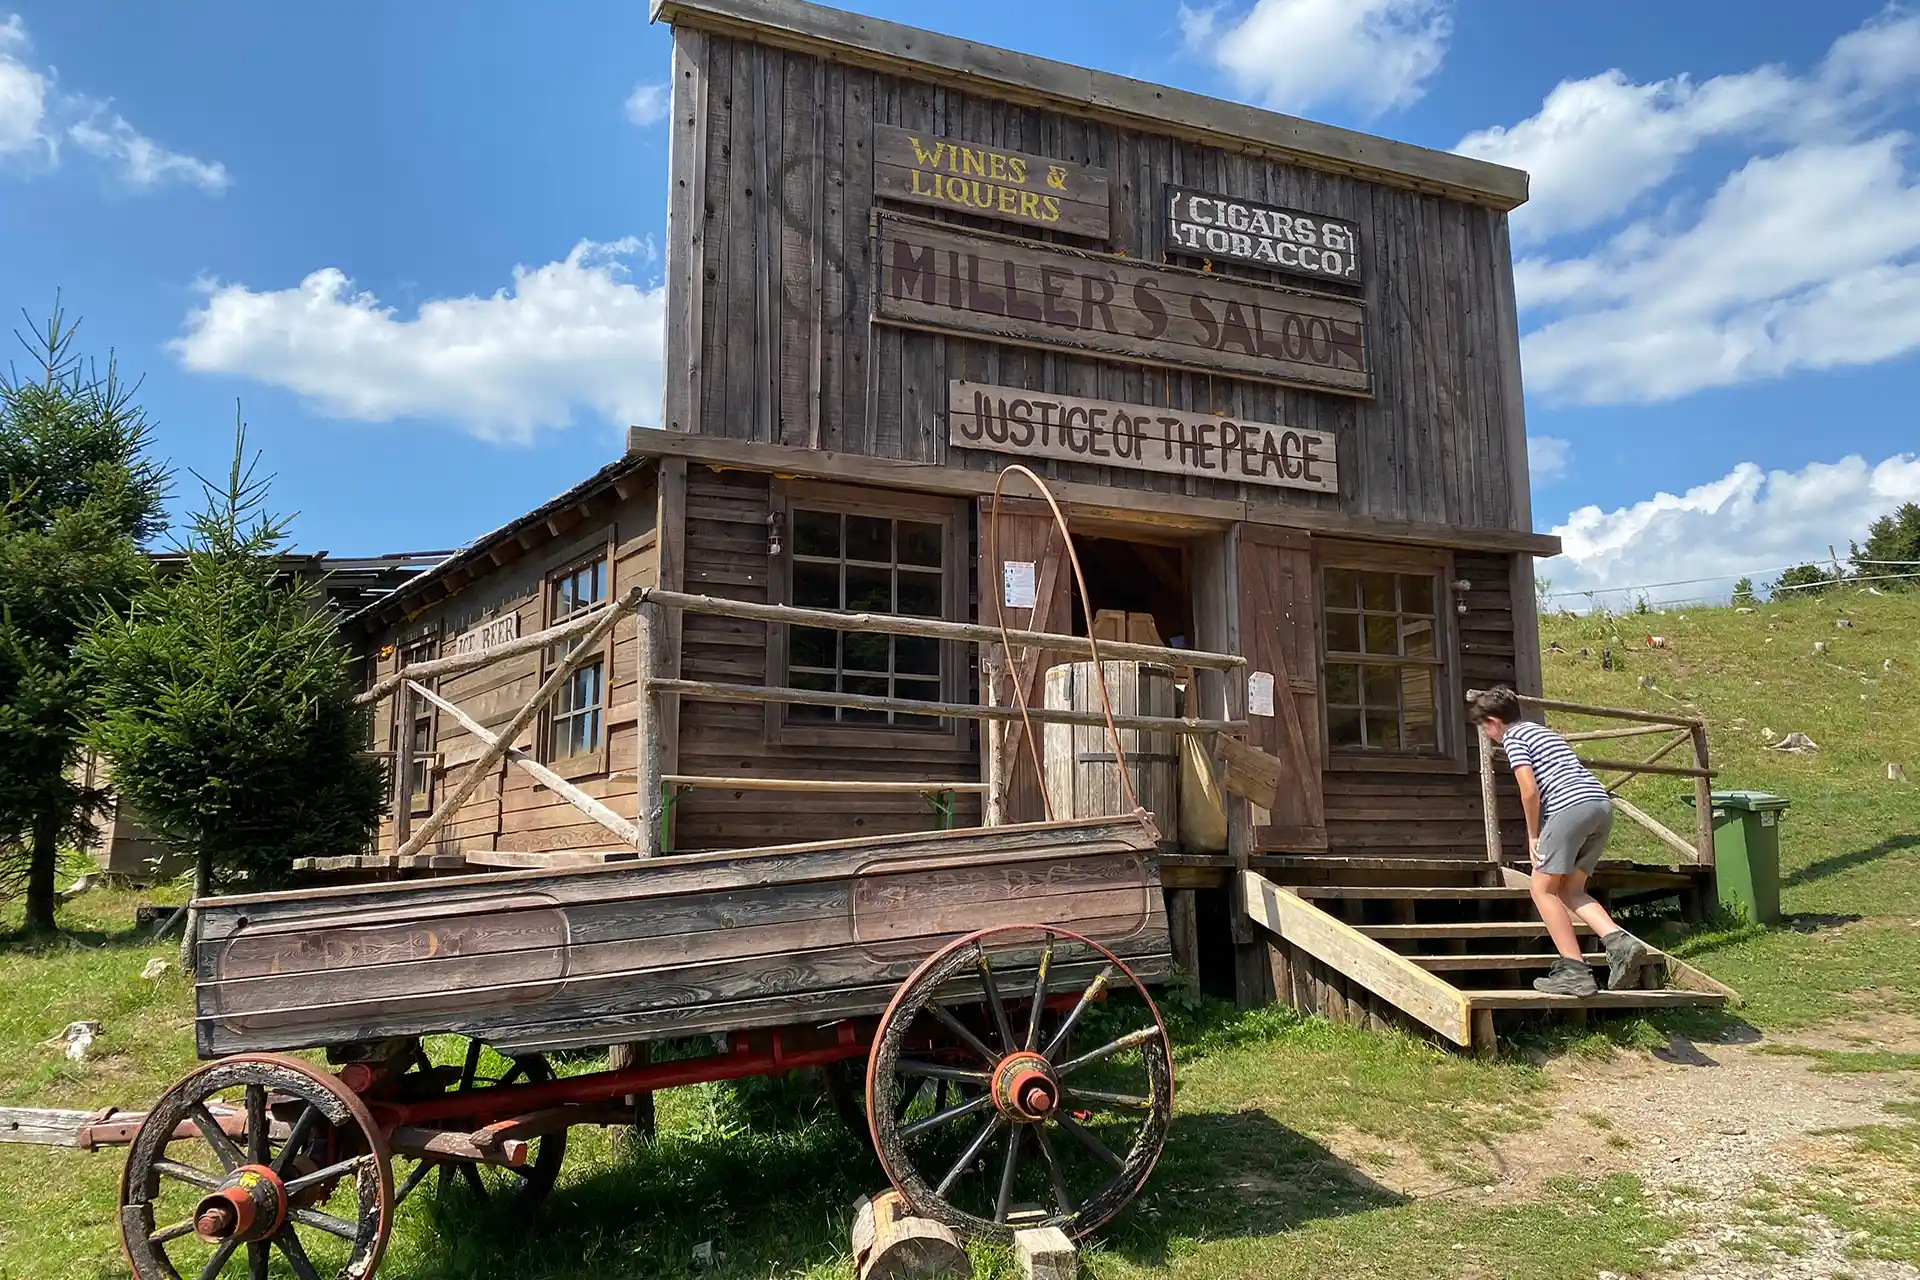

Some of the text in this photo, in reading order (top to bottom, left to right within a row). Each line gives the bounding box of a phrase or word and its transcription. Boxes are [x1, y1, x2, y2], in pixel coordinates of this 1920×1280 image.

[908, 136, 1069, 191] WINES &
[910, 169, 1060, 222] LIQUERS
[1181, 223, 1343, 275] TOBACCO
[1189, 196, 1346, 249] CIGARS &
[891, 239, 1364, 373] MILLER'S SALOON
[960, 390, 1323, 483] JUSTICE OF THE PEACE
[482, 617, 514, 649] BEER
